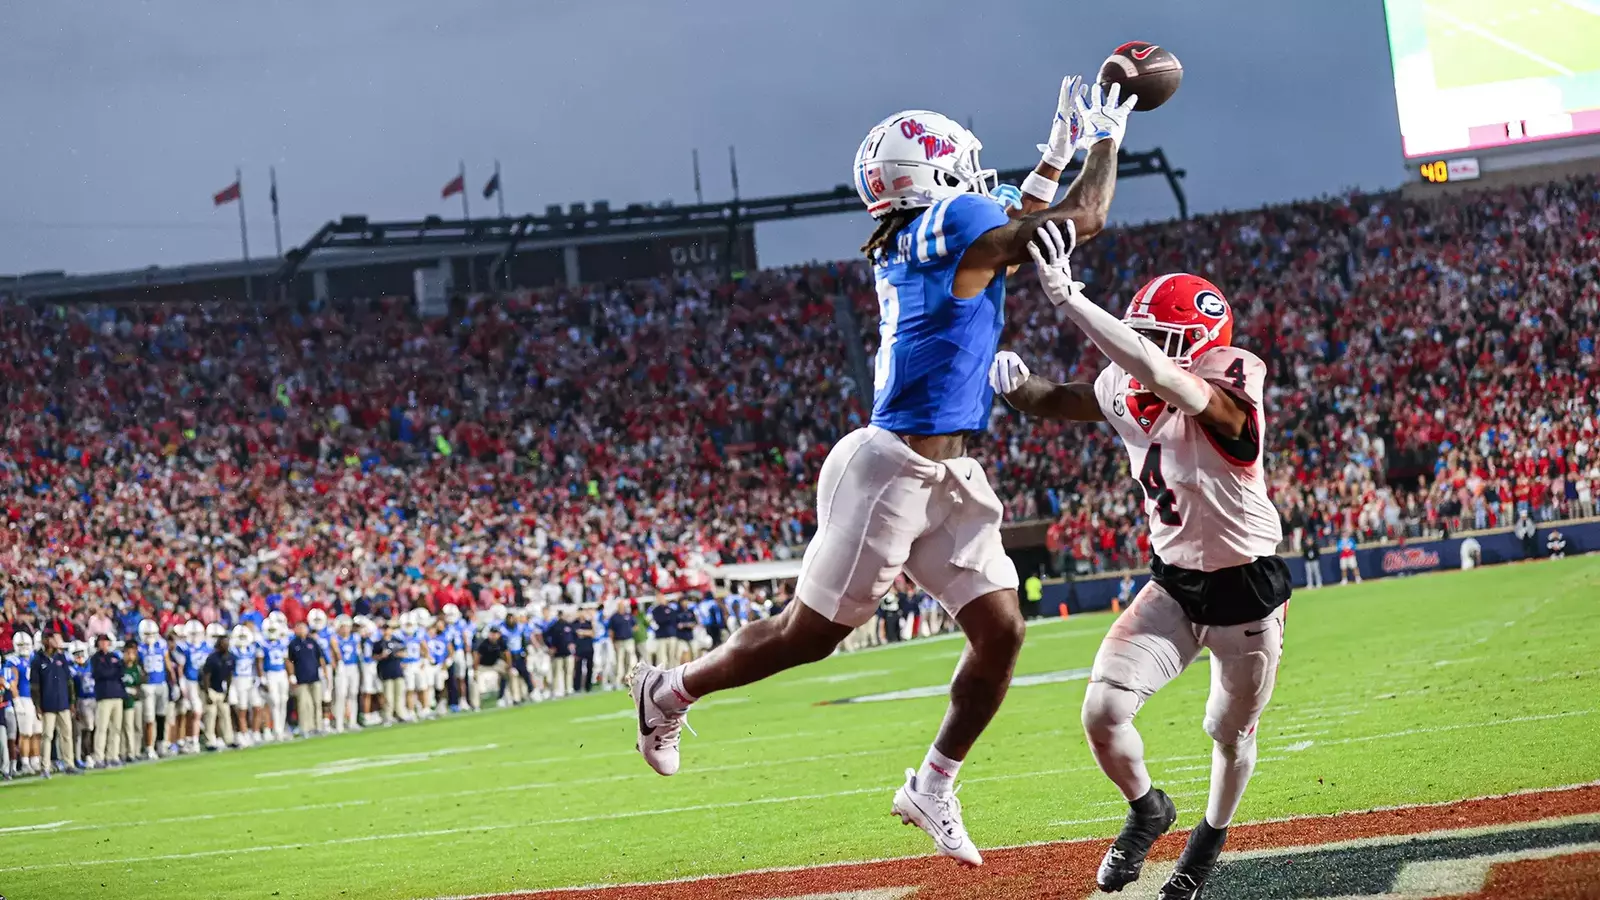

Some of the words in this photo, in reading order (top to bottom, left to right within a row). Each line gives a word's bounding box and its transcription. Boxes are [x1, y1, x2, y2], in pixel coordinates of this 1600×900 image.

[901, 119, 926, 139] Ole
[917, 135, 956, 160] Miss
[1420, 160, 1448, 182] 40
[1195, 291, 1226, 317] G
[1225, 357, 1246, 390] 4
[1139, 442, 1183, 527] 4
